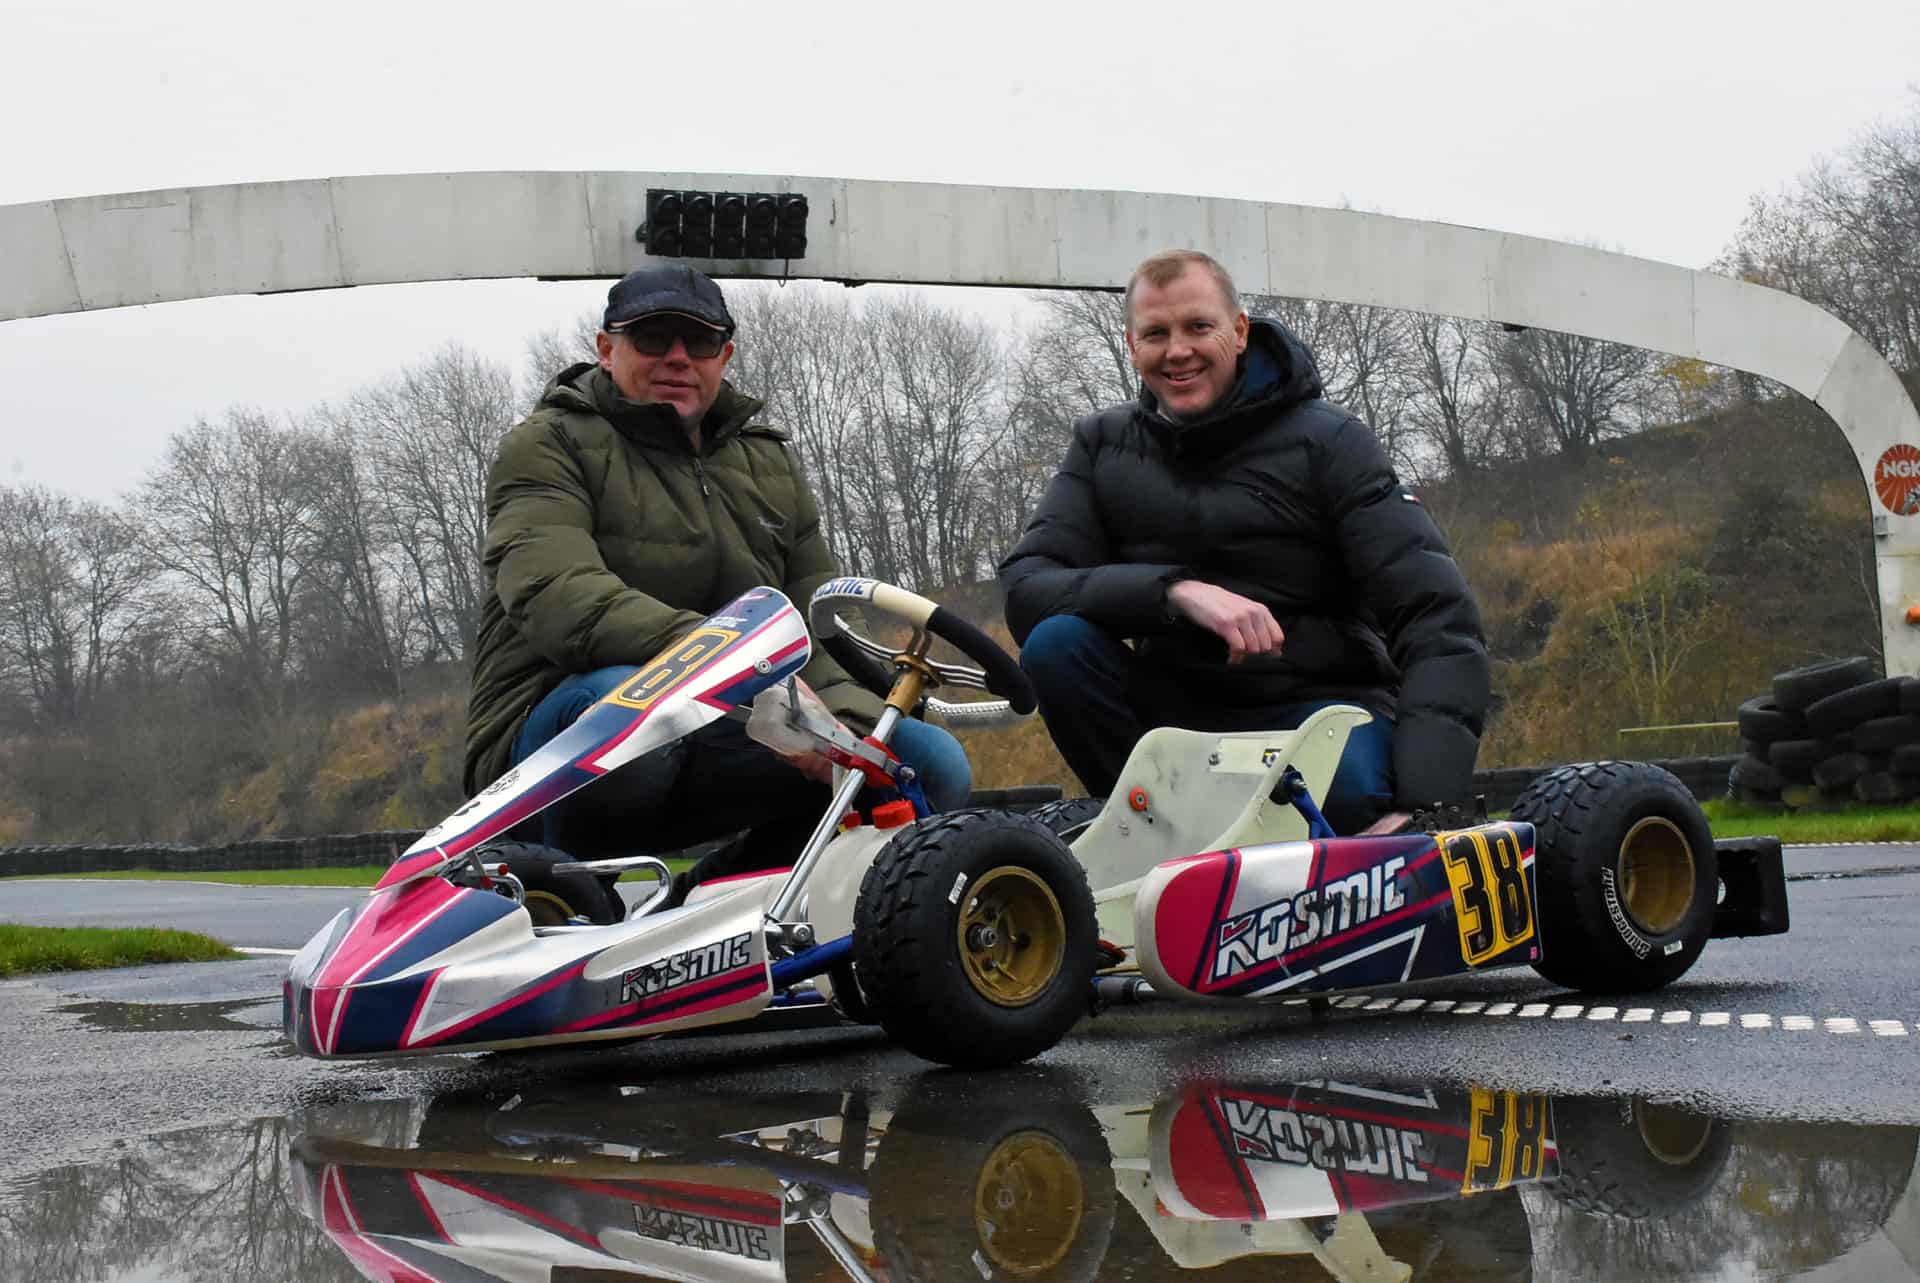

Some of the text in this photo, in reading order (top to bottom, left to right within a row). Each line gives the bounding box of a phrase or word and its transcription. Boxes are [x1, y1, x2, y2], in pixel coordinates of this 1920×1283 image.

[1883, 460, 1920, 479] NGK
[1215, 856, 1406, 977] KOSMIC
[1445, 829, 1531, 959] 38
[622, 932, 752, 1003] KOSMIC
